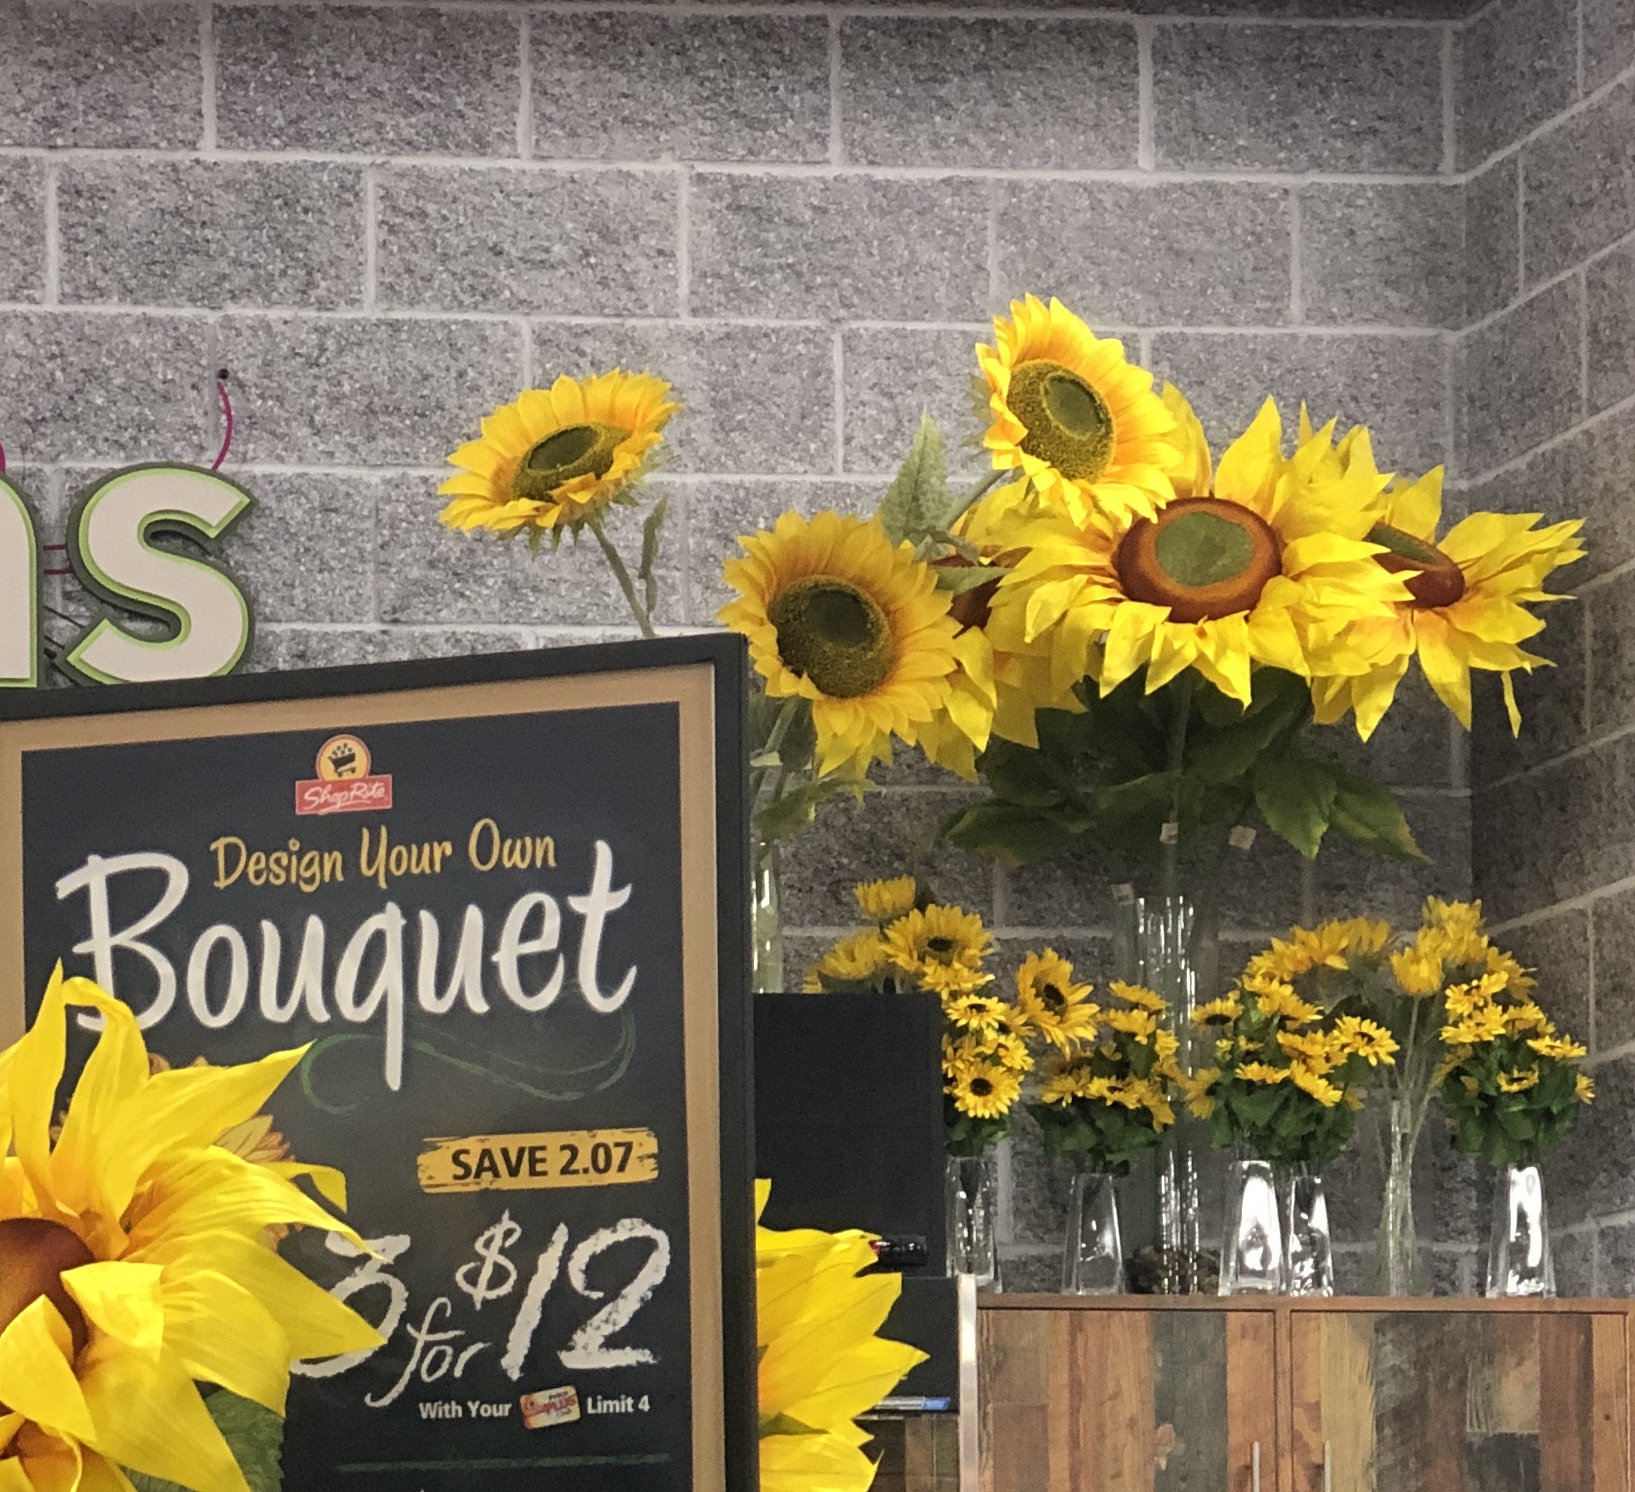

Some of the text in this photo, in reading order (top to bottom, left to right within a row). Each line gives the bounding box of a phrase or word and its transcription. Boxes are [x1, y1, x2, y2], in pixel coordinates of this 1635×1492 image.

[302, 781, 386, 812] ShopRite
[210, 818, 556, 893] Design Your Own
[56, 840, 638, 1092] Bouquet
[451, 1141, 635, 1181] SAVE 2.07
[290, 1210, 671, 1409] 3 for $12
[419, 1401, 463, 1419] With
[467, 1400, 512, 1418] Your
[587, 1394, 634, 1415] Limit
[638, 1395, 651, 1413] 4
